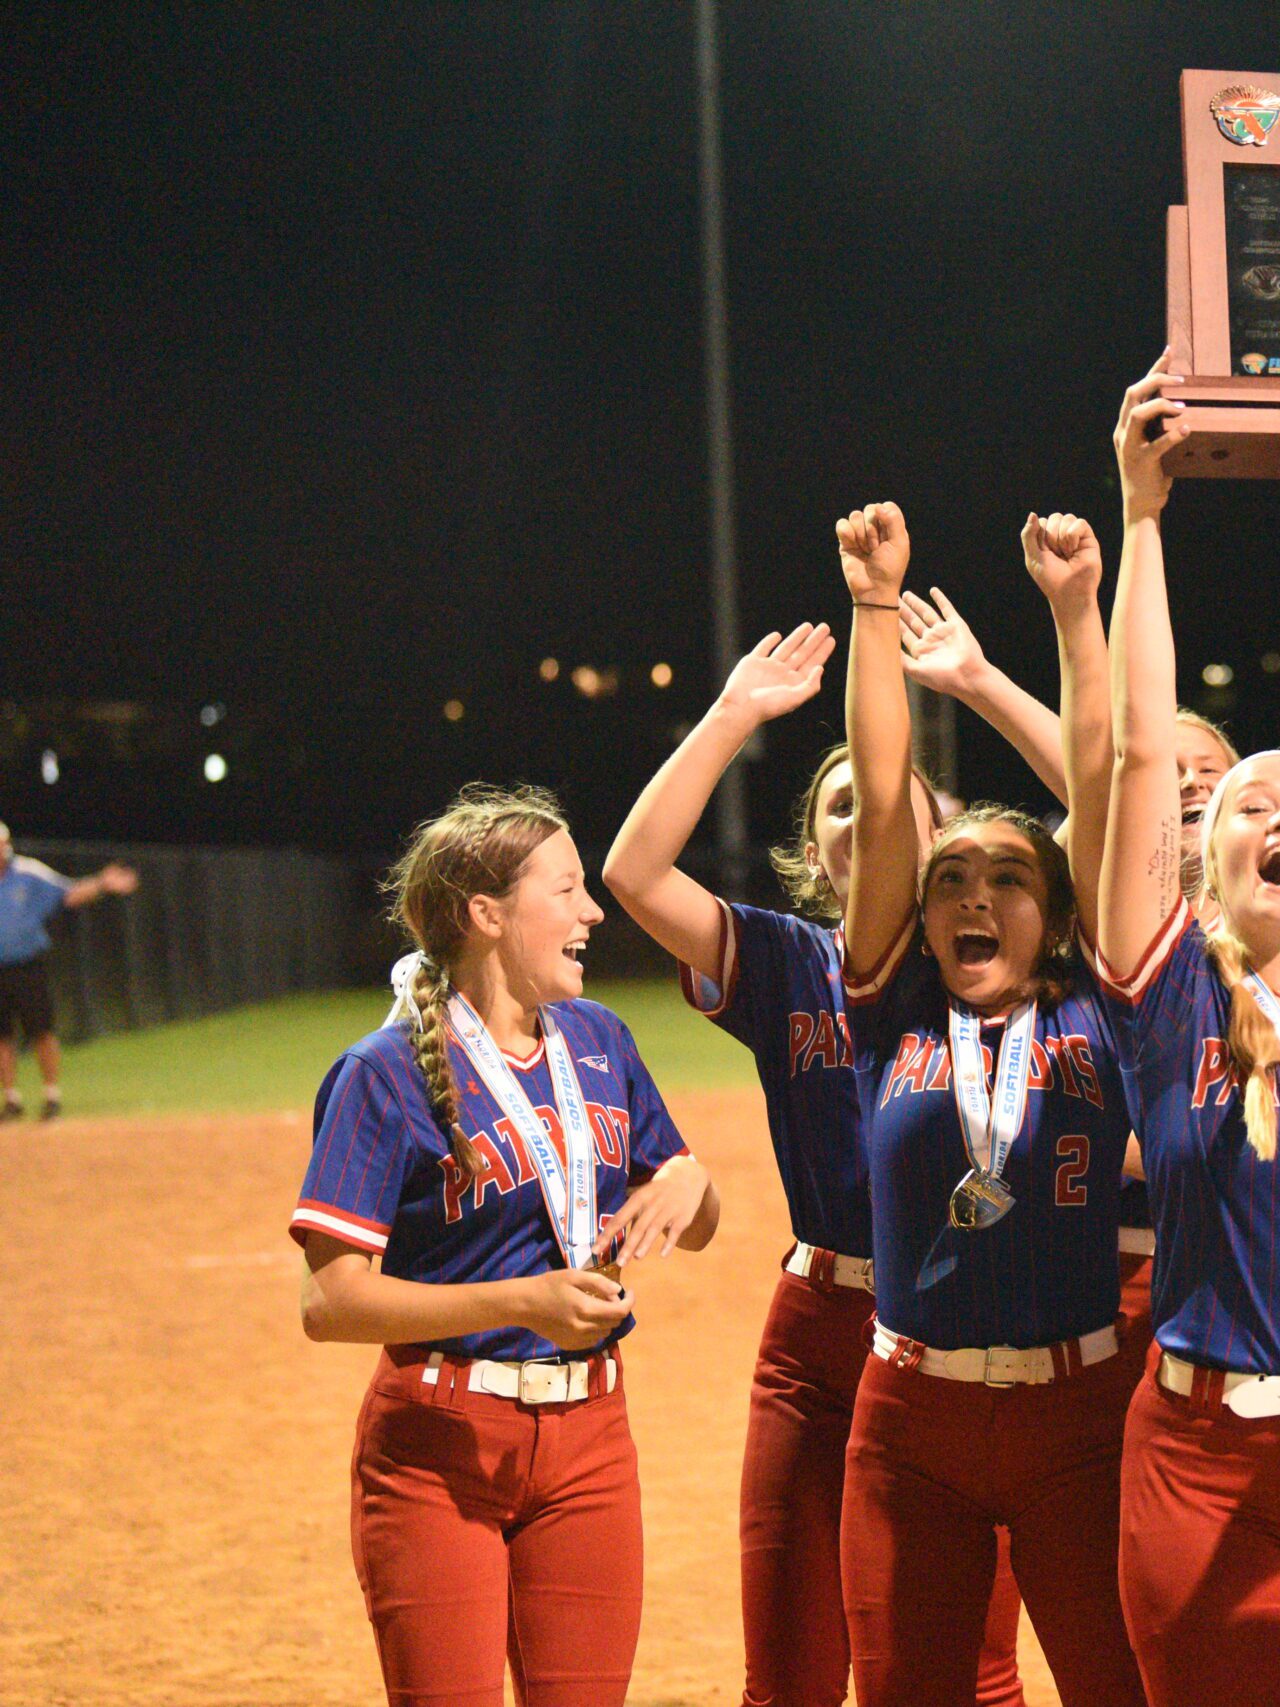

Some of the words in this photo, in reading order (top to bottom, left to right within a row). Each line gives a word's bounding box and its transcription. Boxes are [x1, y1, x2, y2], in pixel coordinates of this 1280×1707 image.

[555, 1050, 582, 1132] SOFTBALL
[1004, 1036, 1024, 1115] SOFTBALL
[508, 1093, 557, 1178] SOFTBALL
[1055, 1135, 1090, 1206] 2
[575, 1159, 584, 1194] FLORIDA
